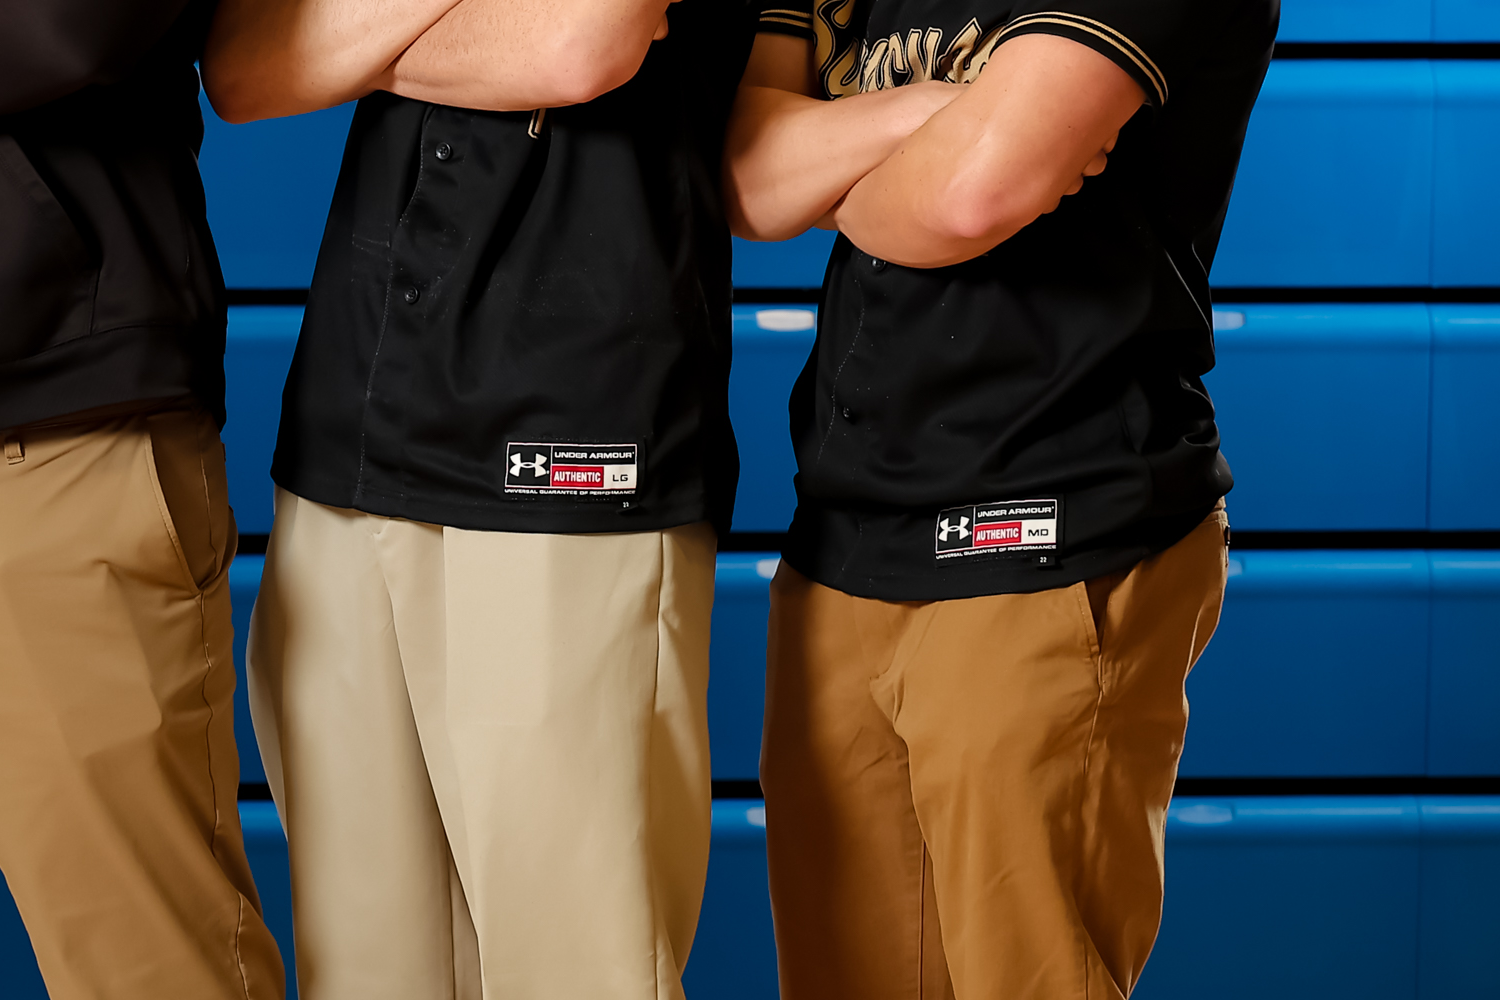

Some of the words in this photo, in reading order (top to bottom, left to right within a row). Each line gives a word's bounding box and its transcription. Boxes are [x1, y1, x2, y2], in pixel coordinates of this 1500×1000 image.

[554, 451, 588, 459] UNDER
[589, 451, 633, 459] ARMOUR
[553, 471, 602, 483] AUTHENTIC
[612, 474, 629, 482] LG
[977, 509, 1007, 517] UNDER
[1008, 507, 1052, 515] ARMOUR
[976, 527, 1019, 541] AUTHENTIC
[1028, 529, 1049, 537] MD
